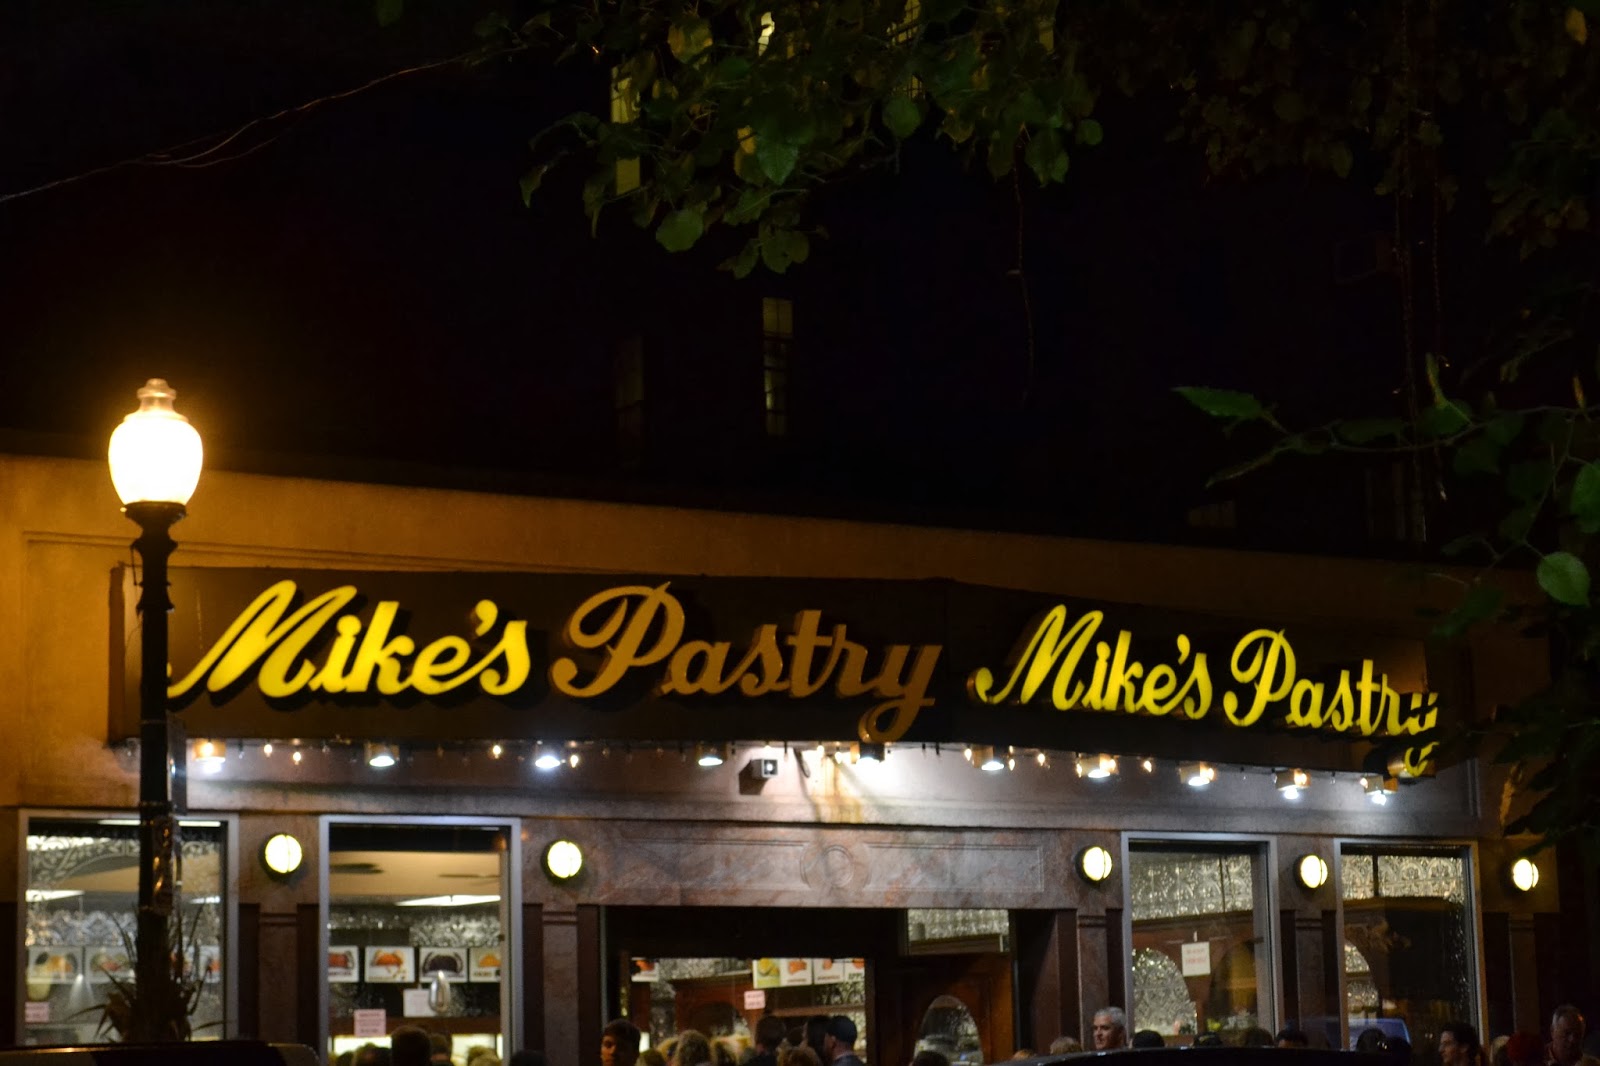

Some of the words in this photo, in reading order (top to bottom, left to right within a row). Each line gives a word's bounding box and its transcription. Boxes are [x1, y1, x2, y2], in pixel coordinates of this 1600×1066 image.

[167, 580, 530, 697] Mike's
[552, 581, 942, 742] Pastry
[974, 604, 1212, 719] Mike's
